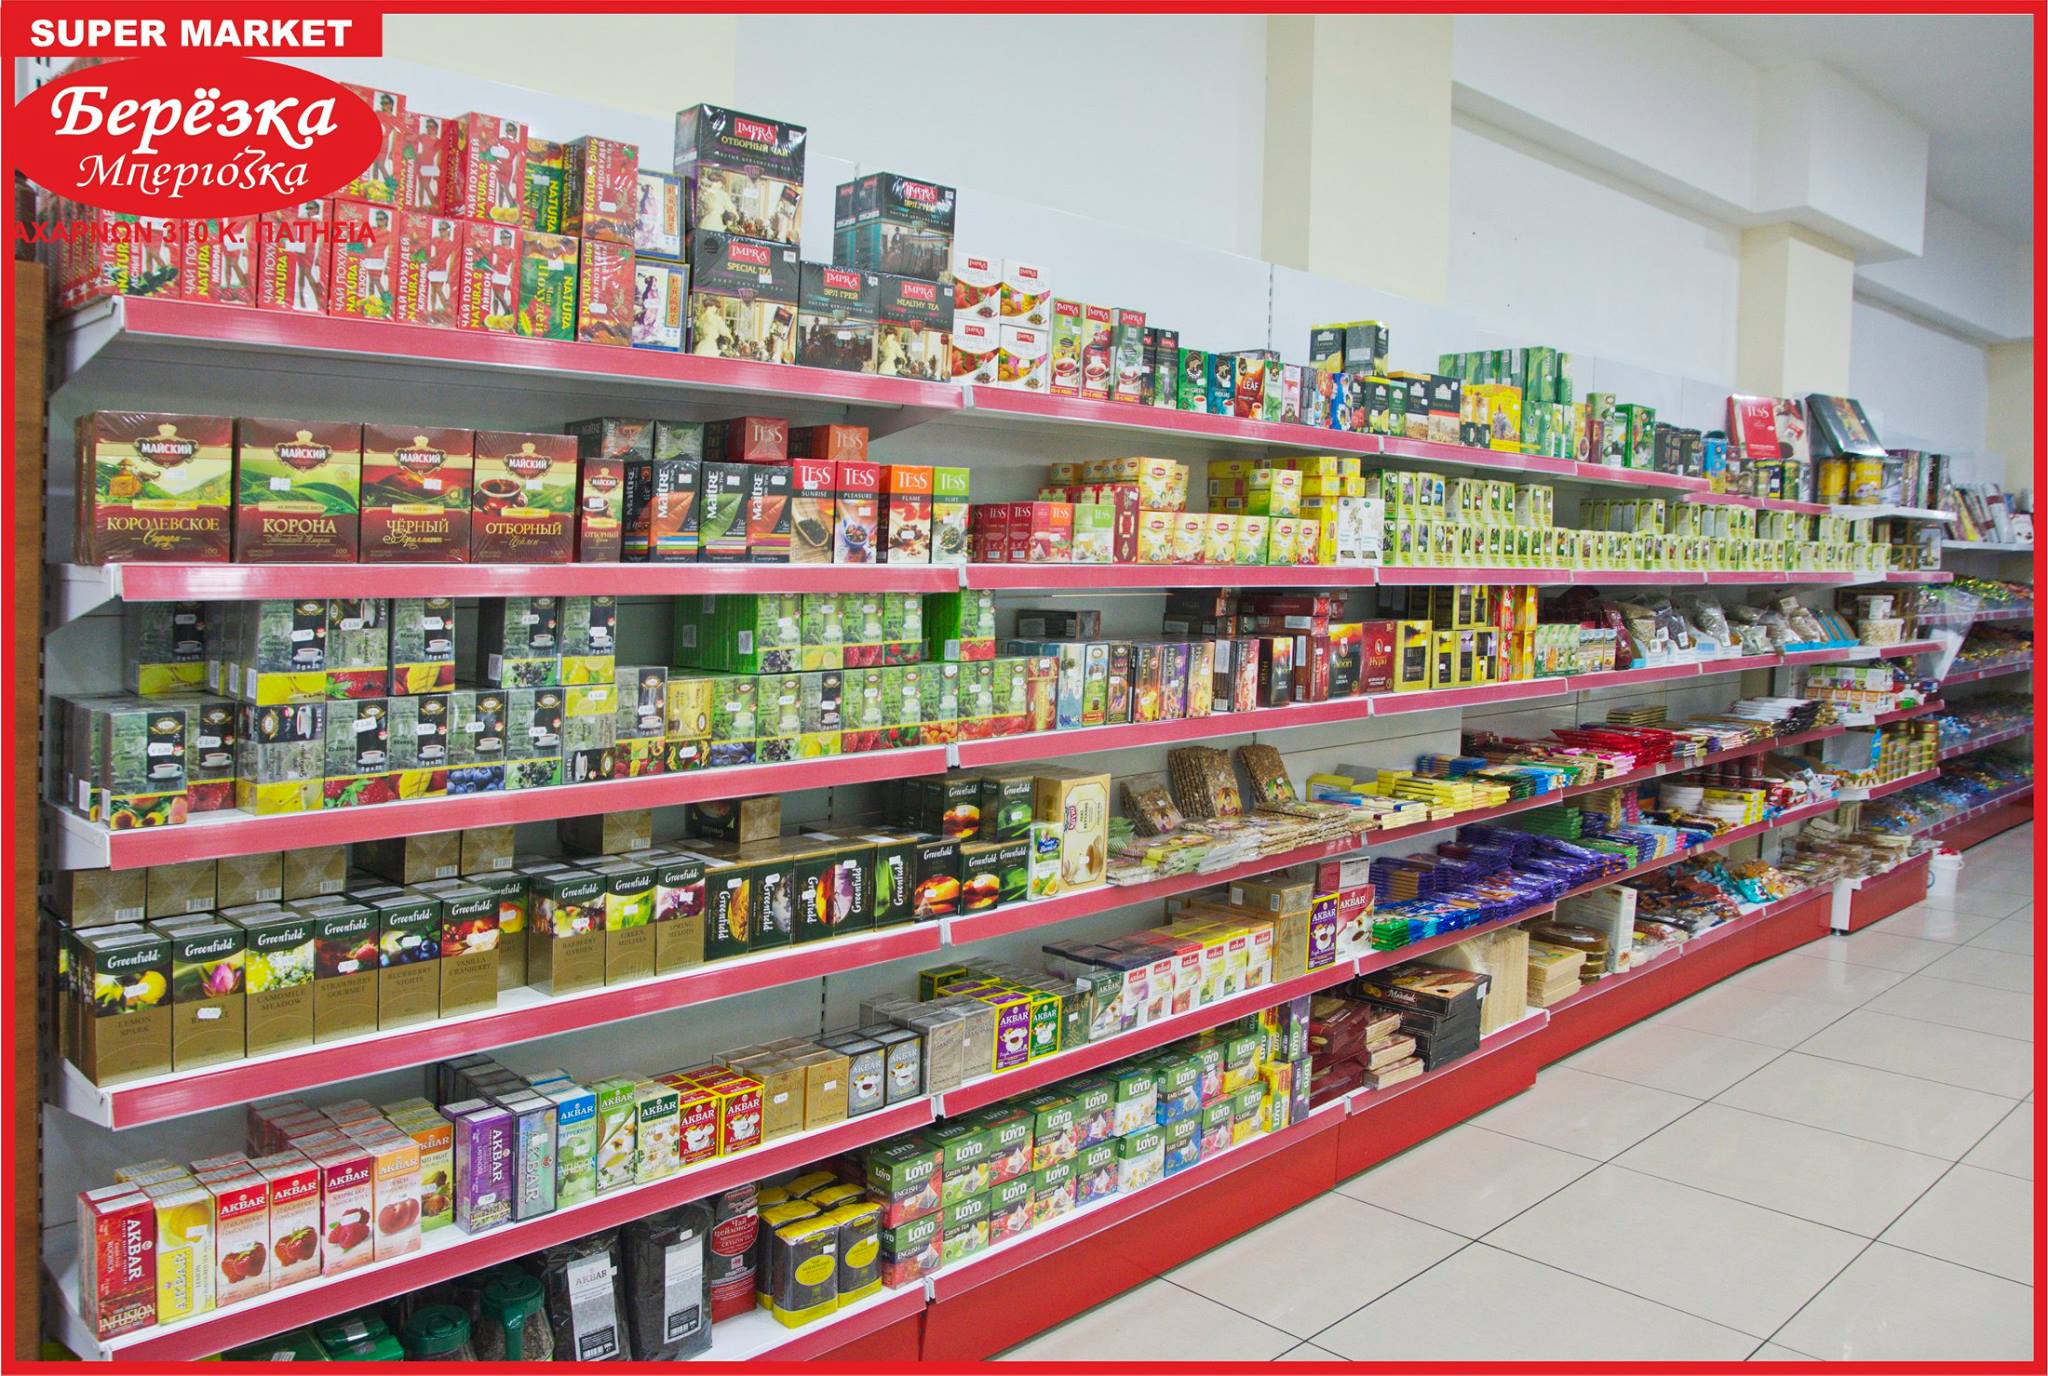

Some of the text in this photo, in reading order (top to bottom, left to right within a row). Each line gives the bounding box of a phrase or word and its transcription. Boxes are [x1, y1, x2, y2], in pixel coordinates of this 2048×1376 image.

[737, 122, 774, 142] IMPRA
[467, 197, 476, 217] ЧАЙ
[547, 179, 560, 233] NATURA
[730, 245, 767, 264] IMPRA
[198, 244, 210, 296] NATURA
[726, 262, 757, 275] SPECIAL
[185, 272, 196, 295] ЧАЙ
[276, 255, 288, 305] NATURA
[398, 236, 411, 320] ЧАЙ ПОХУДЕЙ
[581, 242, 593, 314] NATURA plus
[826, 272, 858, 289] IMPRA
[346, 264, 359, 313] NATURA
[461, 247, 475, 328] ЧАЙ ПОХУДЕЙ
[903, 285, 935, 300] IMPRA
[335, 288, 344, 311] ЧАЙ
[407, 272, 419, 321] NATURA
[561, 276, 574, 330] NATURA
[896, 299, 926, 309] HEALTHY
[470, 283, 482, 329] NATURA
[1056, 303, 1079, 316] IMPRA
[1087, 306, 1110, 321] IMPRA
[140, 441, 193, 456] МАЙСКИЙ
[280, 447, 326, 461] МАЙСКИЙ
[399, 452, 441, 464] МАЙСКИЙ
[508, 458, 548, 470] МАЙСКИЙ
[801, 465, 832, 484] TESS
[844, 467, 875, 487] TESS
[897, 471, 928, 489] TESS
[940, 473, 966, 490] TESS
[801, 490, 828, 498] SUNRISE
[1014, 507, 1032, 519] TESS
[1052, 507, 1069, 519] TESS
[106, 517, 221, 531] КОРОЛЕВСКОЕ
[262, 517, 337, 535] КОРОНА
[386, 518, 450, 534] ЧЁРНЫЙ
[485, 521, 563, 536] ОТБОРНЫЙ
[949, 784, 977, 799] Greenfield
[1004, 783, 1031, 797] Greenfield
[923, 847, 953, 861] Greenfield
[968, 854, 998, 868] Greenfield
[1000, 848, 1026, 861] Greenfield
[615, 874, 651, 892] Greenfield
[665, 868, 699, 884] Greenfield
[561, 883, 598, 900] Greenfield
[851, 866, 863, 914] Greenfield
[451, 900, 492, 917] Greenfield
[763, 880, 775, 933] Greenfield
[1340, 896, 1367, 908] AKBAR
[390, 910, 432, 927] Greenfield
[717, 890, 731, 940] Greenfield
[1312, 908, 1336, 922] AKBAR
[324, 919, 369, 937] Greenfield
[257, 929, 305, 947] Greenfield
[185, 937, 235, 958] Greenfield
[107, 949, 160, 970] Greenfield
[1001, 1012, 1029, 1026] AKBAR
[1034, 1010, 1057, 1022] AKBAR
[1237, 1038, 1256, 1055] LOYD
[1177, 1069, 1196, 1085] LOYD
[1129, 1078, 1150, 1095] LOYD
[601, 1092, 634, 1109] AKBAR
[1085, 1091, 1108, 1109] LOYD
[1244, 1089, 1262, 1106] LOYD
[560, 1105, 594, 1121] AKBAR
[641, 1101, 677, 1117] AKBAR
[728, 1099, 760, 1115] AKBAR
[1210, 1106, 1230, 1121] LOYD
[682, 1110, 715, 1126] AKBAR
[1048, 1111, 1072, 1128] LOYD
[1001, 1126, 1026, 1143] LOYD
[1174, 1119, 1195, 1136] LOYD
[956, 1142, 983, 1161] LOYD
[1136, 1135, 1158, 1152] LOYD
[492, 1129, 503, 1183] AKBAR
[1088, 1147, 1111, 1166] LOYD
[380, 1159, 418, 1175] AKBAR
[905, 1162, 933, 1181] LOYD
[1046, 1165, 1069, 1183] LOYD
[329, 1169, 369, 1188] AKBAR
[274, 1182, 317, 1200] AKBAR
[894, 1184, 918, 1199] ENGLISH
[1002, 1183, 1027, 1201] LOYD
[220, 1196, 266, 1216] AKBAR
[956, 1201, 982, 1220] LOYD
[908, 1222, 935, 1242] LOYD
[126, 1218, 143, 1281] AKBAR
[576, 1269, 608, 1287] AKBAR
